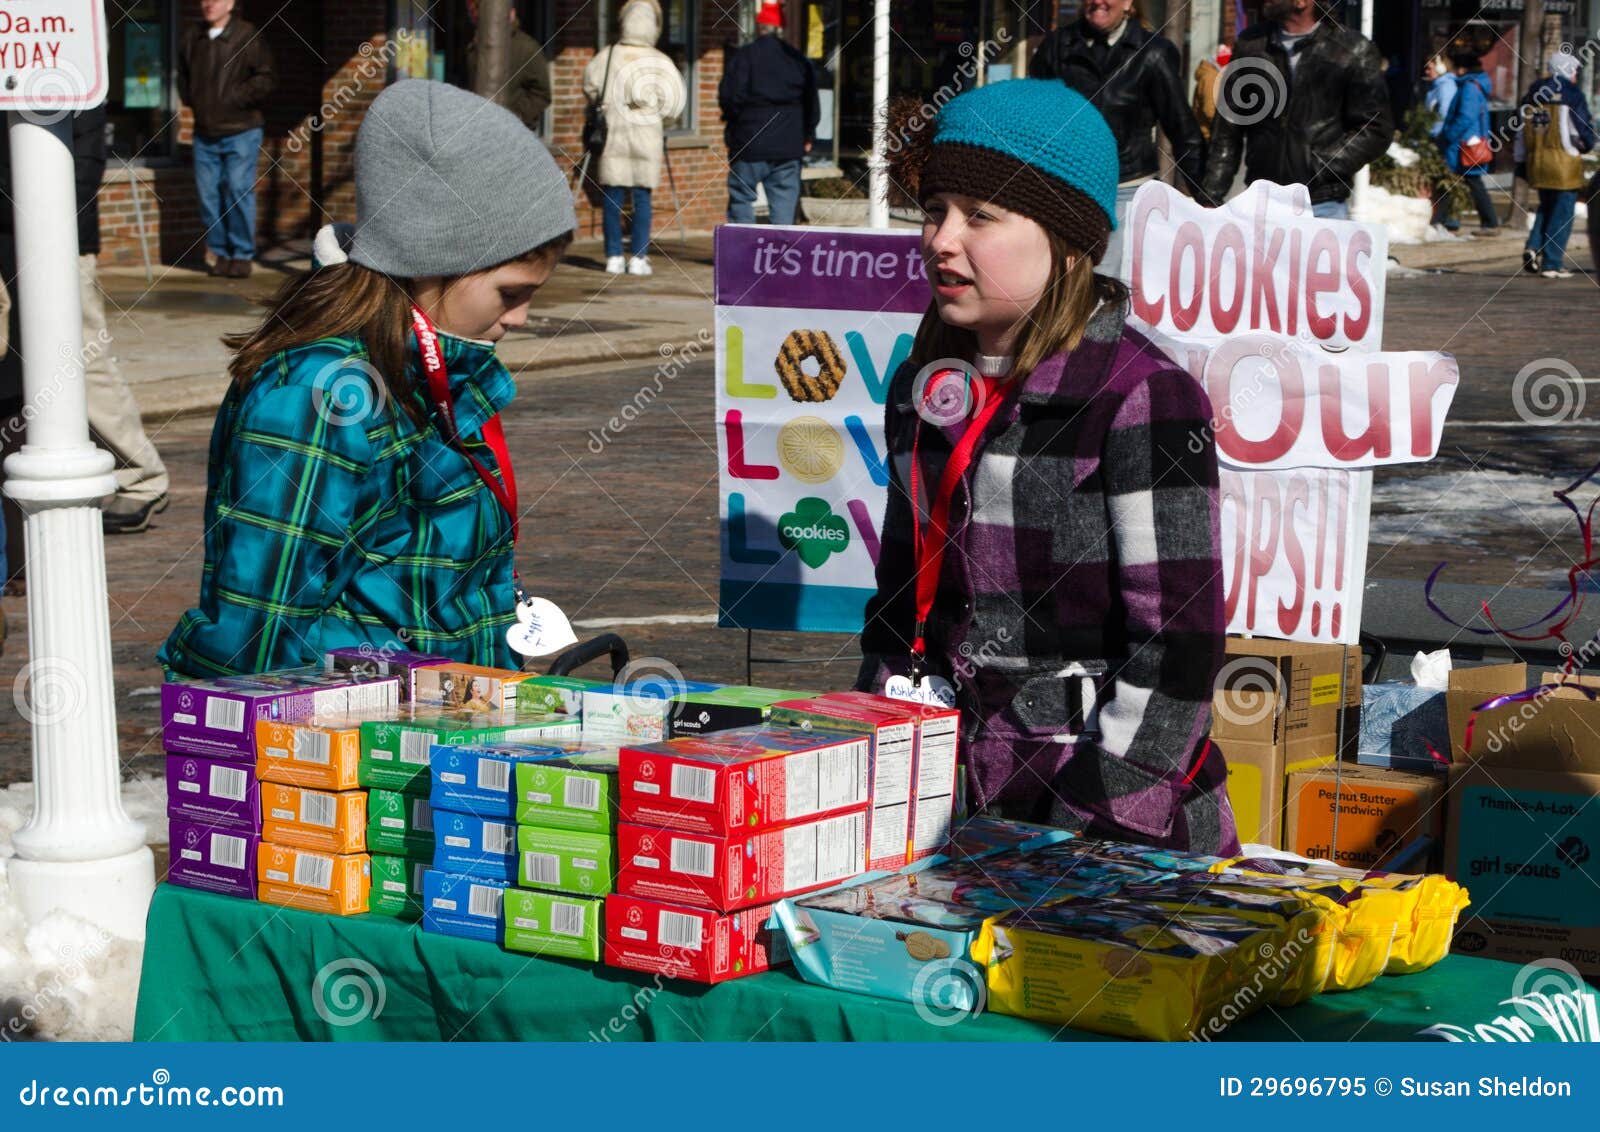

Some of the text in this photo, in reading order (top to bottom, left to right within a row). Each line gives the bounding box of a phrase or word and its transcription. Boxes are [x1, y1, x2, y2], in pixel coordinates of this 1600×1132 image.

[753, 238, 801, 277] it's
[811, 240, 898, 279] time
[1131, 182, 1373, 342] Cookies
[1206, 333, 1457, 463] Our
[783, 524, 846, 542] cookies
[1318, 789, 1397, 806] Peanut Butter
[1330, 803, 1384, 817] Sandwich
[1306, 846, 1379, 864] girl scouts
[1470, 856, 1561, 879] girl scouts
